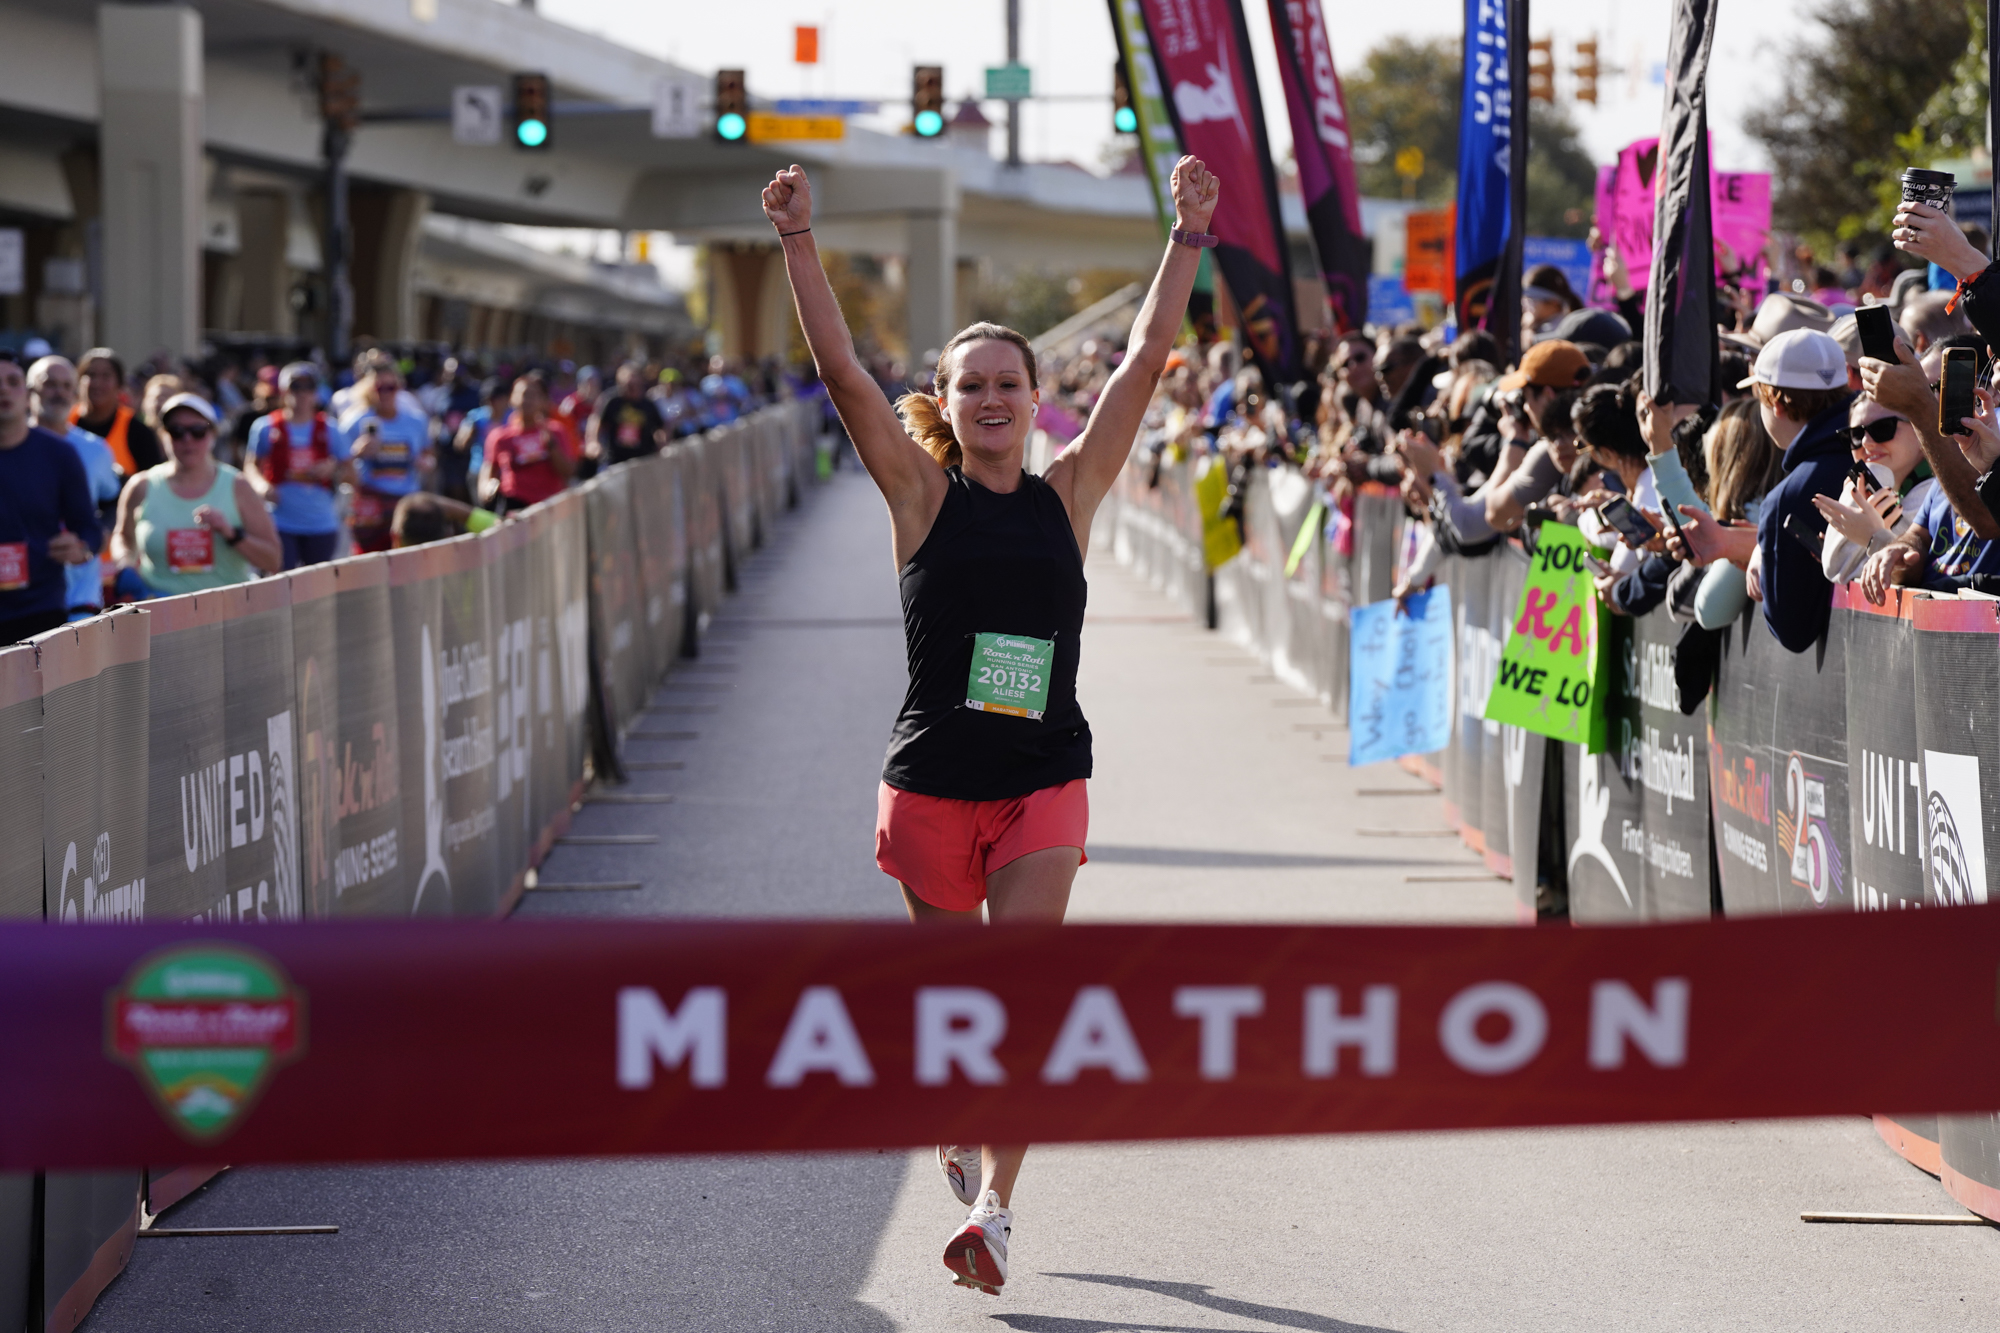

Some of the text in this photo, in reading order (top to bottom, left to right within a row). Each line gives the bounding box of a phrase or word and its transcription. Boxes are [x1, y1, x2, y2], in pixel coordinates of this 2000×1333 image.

[983, 647, 1013, 660] Rock
[1021, 653, 1045, 666] Roll
[987, 657, 1039, 670] RUNNING SERIES
[977, 666, 1042, 693] 20132
[1005, 666, 1033, 674] ANTONIO
[1500, 658, 1547, 696] WE
[992, 687, 1026, 699] ALIESE
[992, 706, 1019, 715] MARATHON
[181, 750, 265, 873] UNITED
[1862, 748, 1924, 866] UNIT
[616, 977, 1691, 1089] MARATHON
